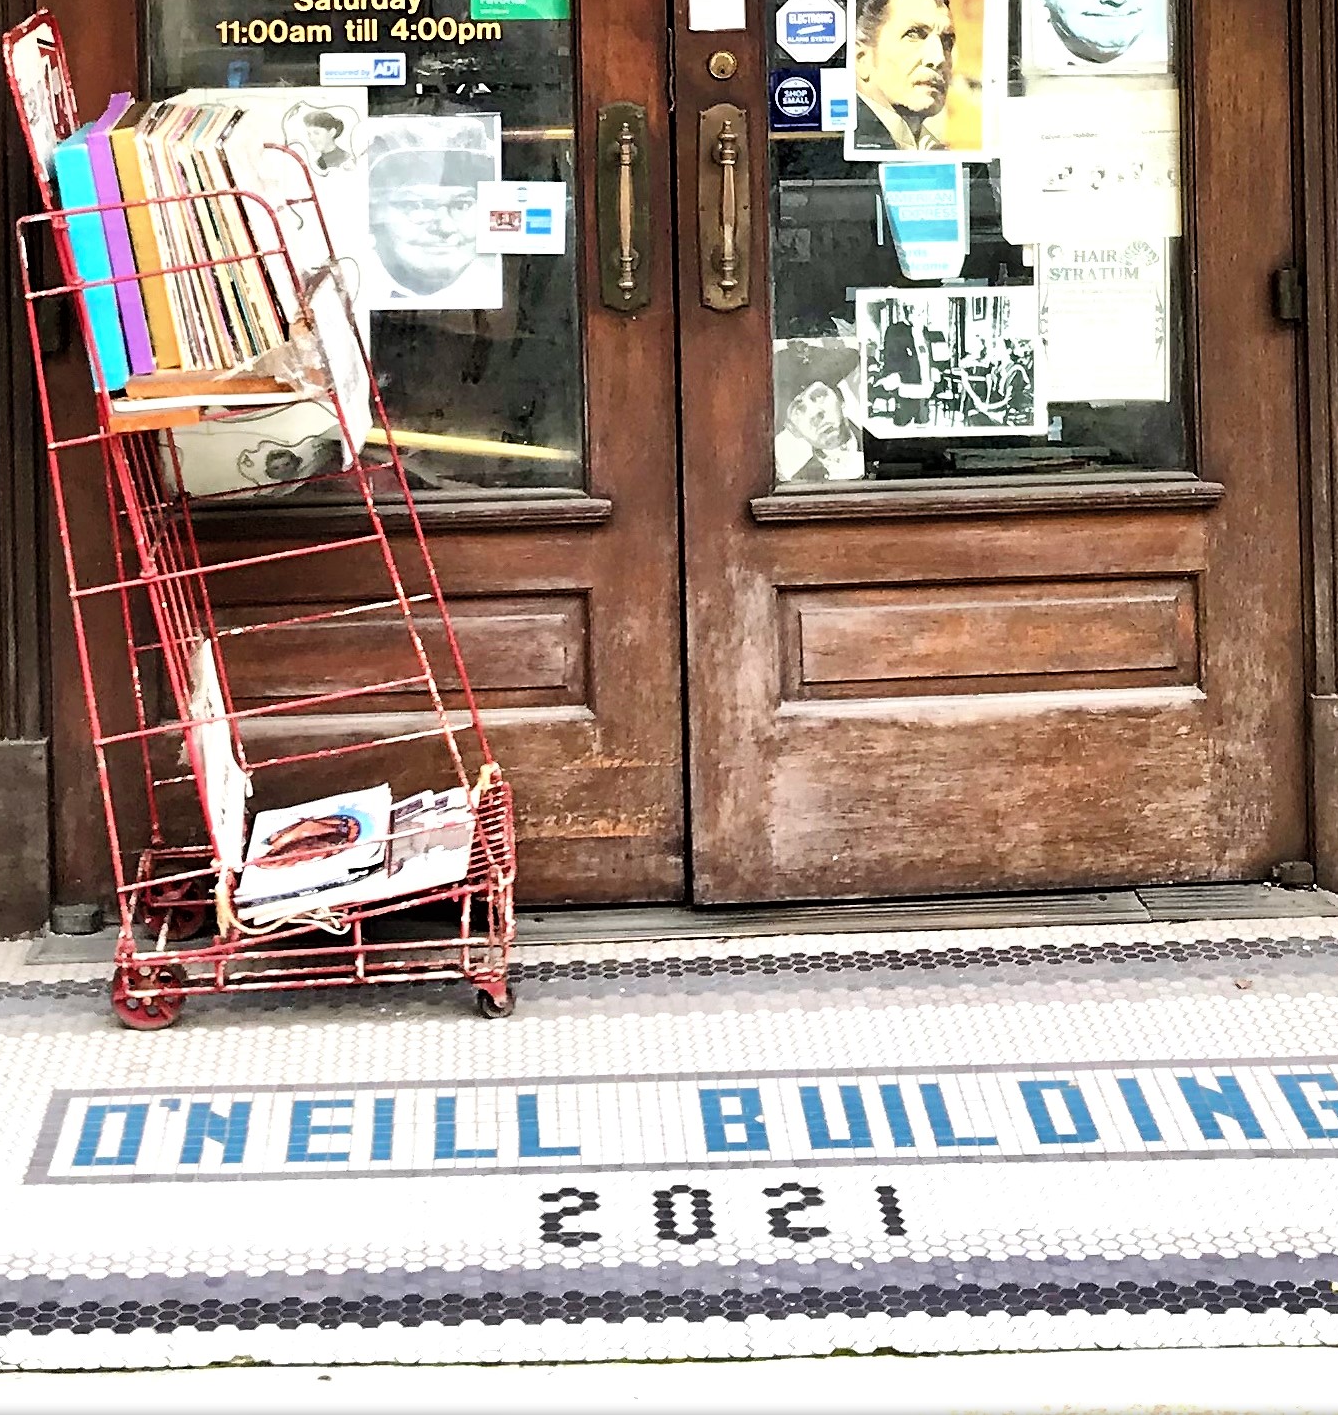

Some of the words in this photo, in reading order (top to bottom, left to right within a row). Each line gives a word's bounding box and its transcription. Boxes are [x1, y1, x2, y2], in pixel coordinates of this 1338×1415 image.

[789, 14, 833, 24] ELECTRONIC
[215, 20, 332, 45] 11:00am
[344, 18, 378, 43] till
[390, 17, 502, 45] 4:00pm
[374, 60, 400, 77] ADT
[887, 192, 953, 202] AMERICAN
[902, 207, 957, 218] EXPRESS
[1074, 250, 1117, 262] HAIR
[1049, 267, 1139, 281] STRATUM
[70, 1091, 583, 1167] O'NEILL
[538, 1182, 908, 1249] 2021
